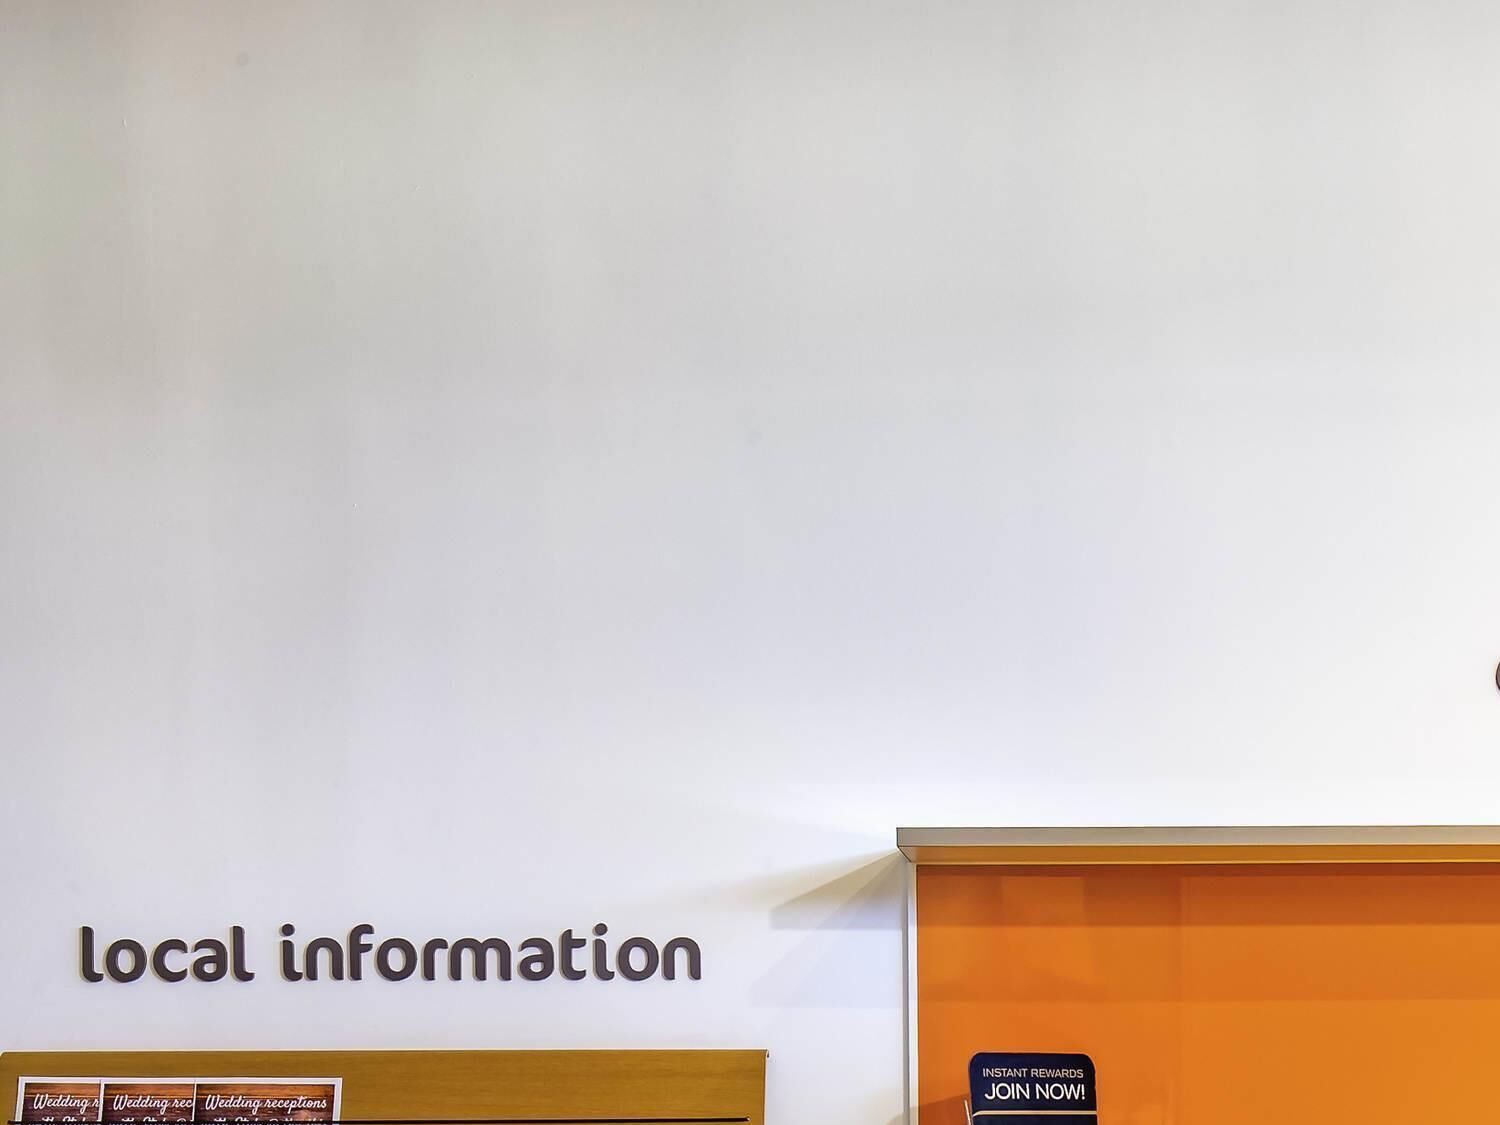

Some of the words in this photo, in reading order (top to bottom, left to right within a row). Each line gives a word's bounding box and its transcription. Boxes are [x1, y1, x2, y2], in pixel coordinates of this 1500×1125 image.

[79, 925, 254, 982] local
[279, 922, 702, 982] information
[982, 1067, 1028, 1078] INSTANT
[1031, 1068, 1084, 1079] REWARDS
[984, 1082, 1030, 1100] JOIN
[1036, 1083, 1086, 1100] NOW!
[33, 1094, 91, 1114] Wedding
[113, 1094, 171, 1115] Wedding
[205, 1094, 262, 1115] Wedding
[264, 1096, 327, 1114] receptions
